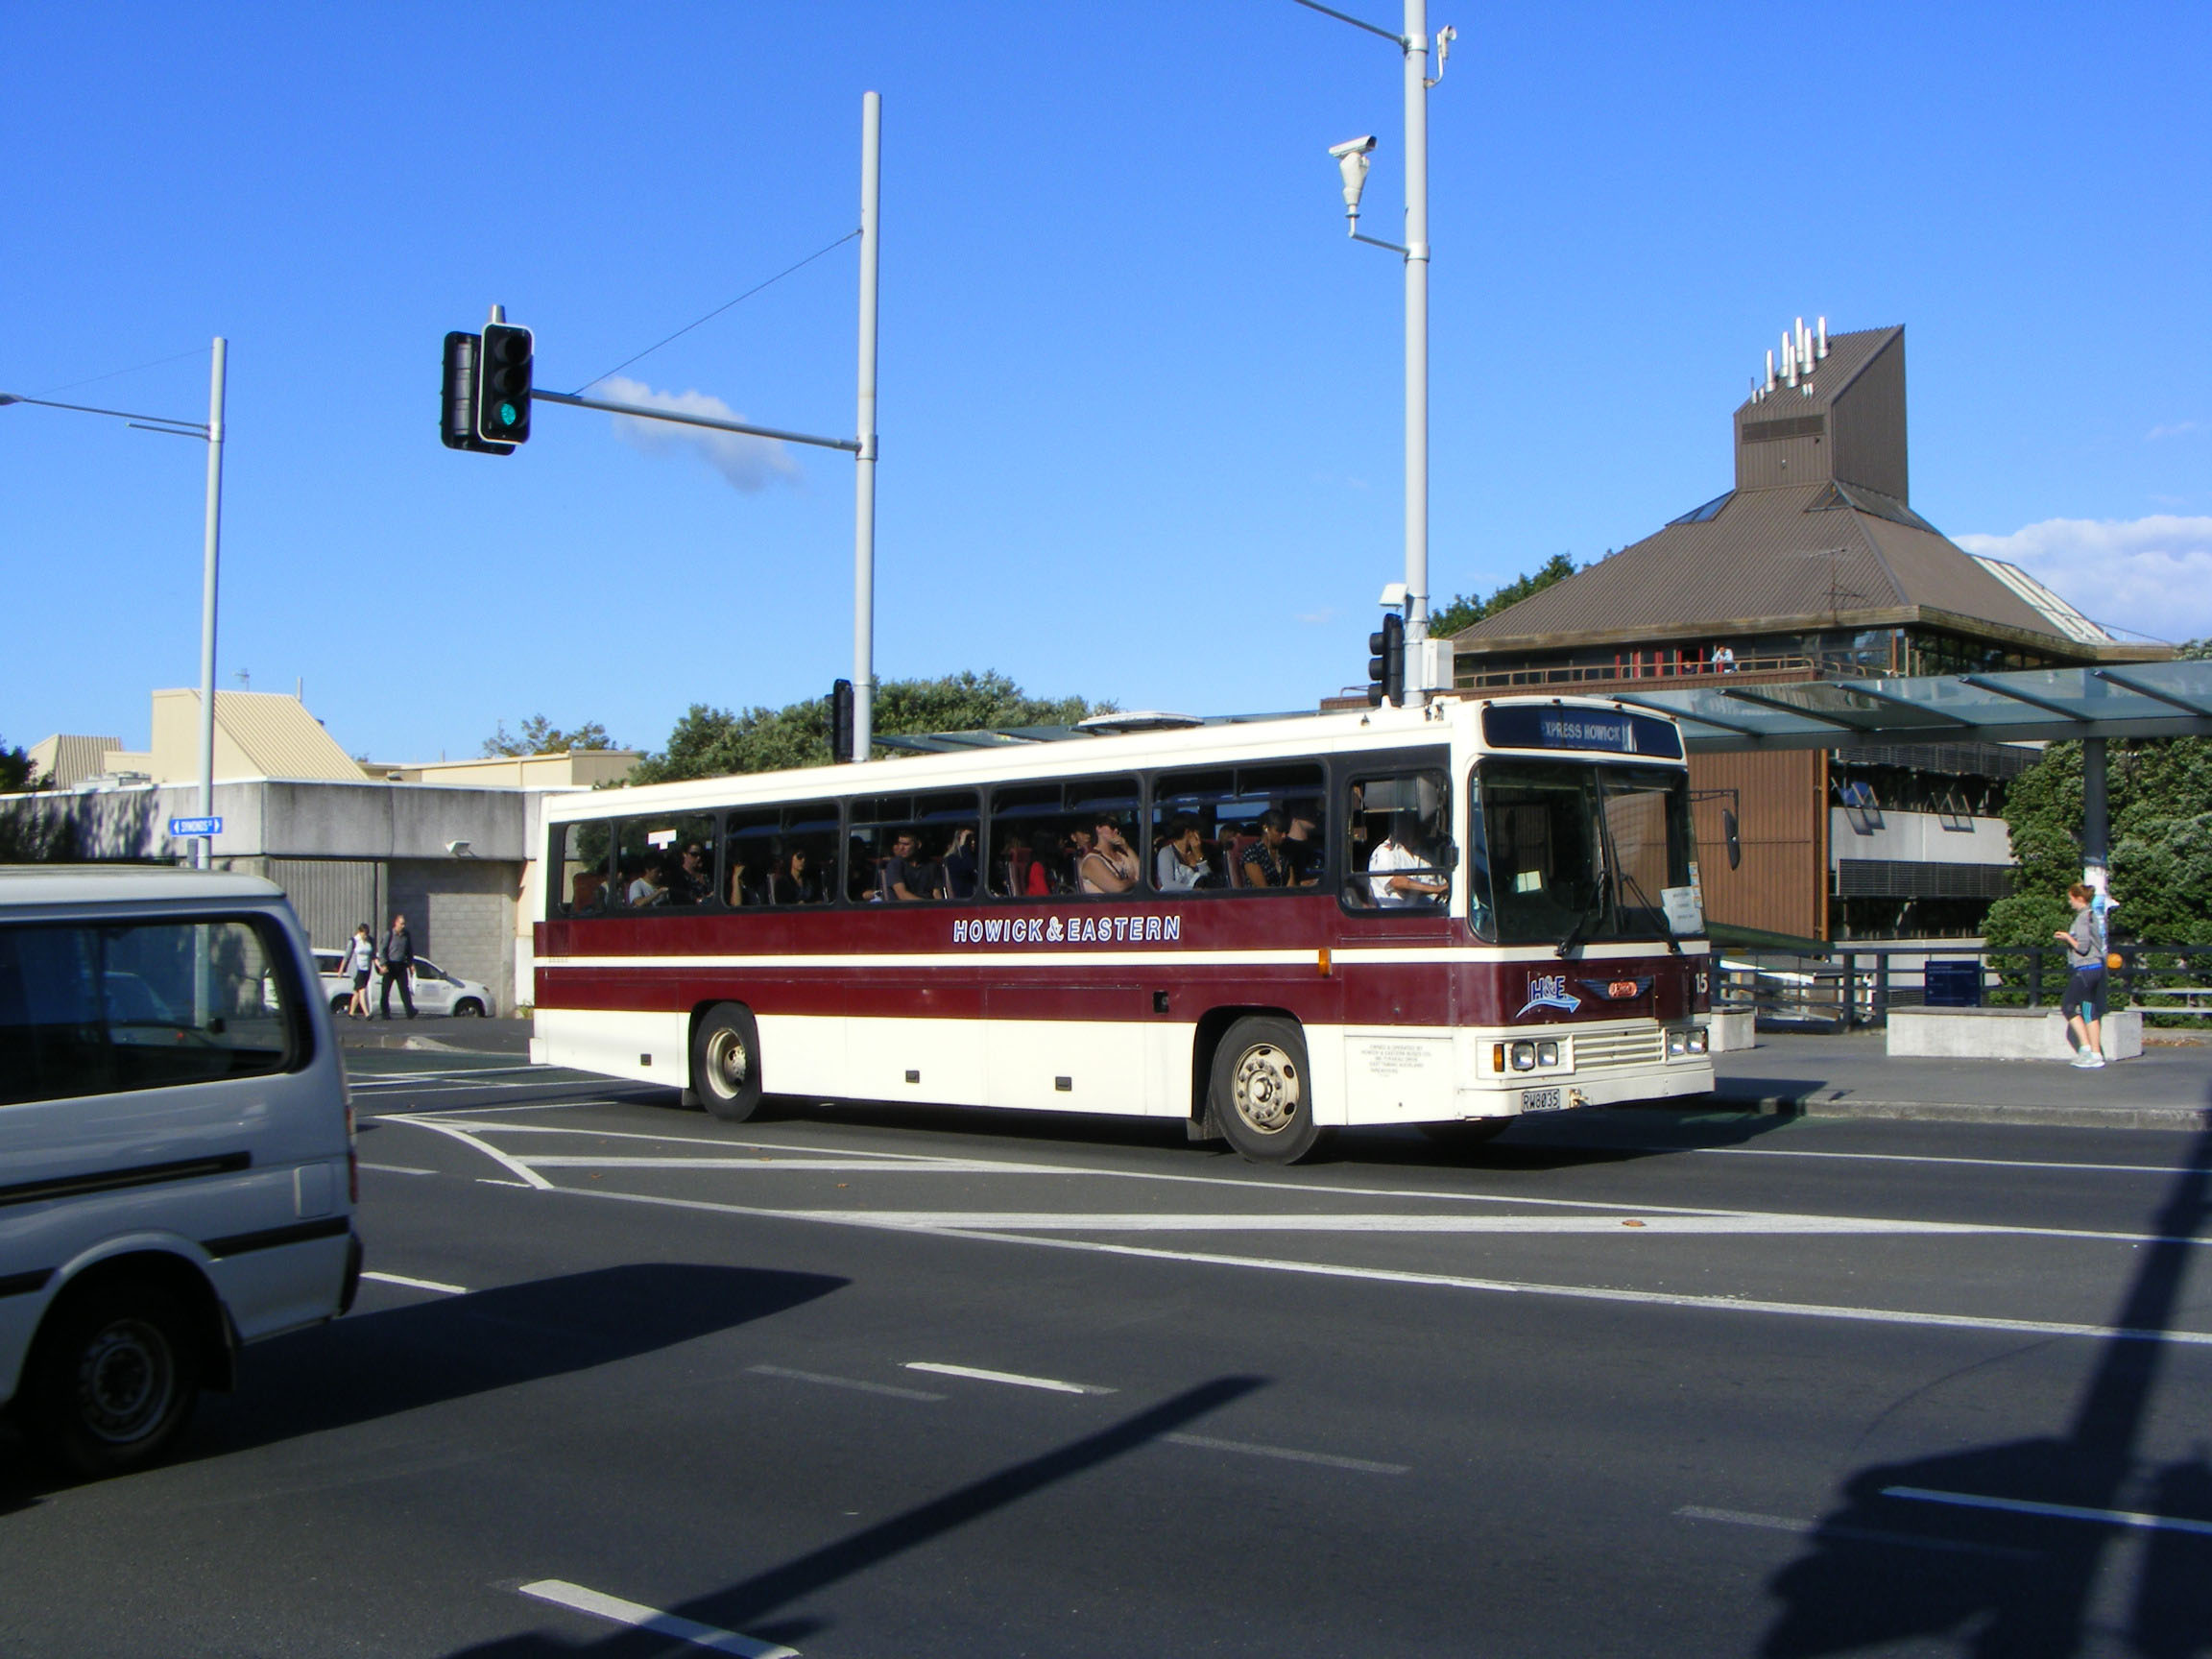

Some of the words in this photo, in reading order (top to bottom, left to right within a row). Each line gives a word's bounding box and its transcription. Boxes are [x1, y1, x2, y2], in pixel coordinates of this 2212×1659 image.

[1541, 721, 1582, 739] XPRESS
[1584, 724, 1621, 742] HOWICK
[953, 918, 1044, 943] HOWICK
[1067, 915, 1181, 943] EASTERN
[1695, 973, 1709, 994] 15
